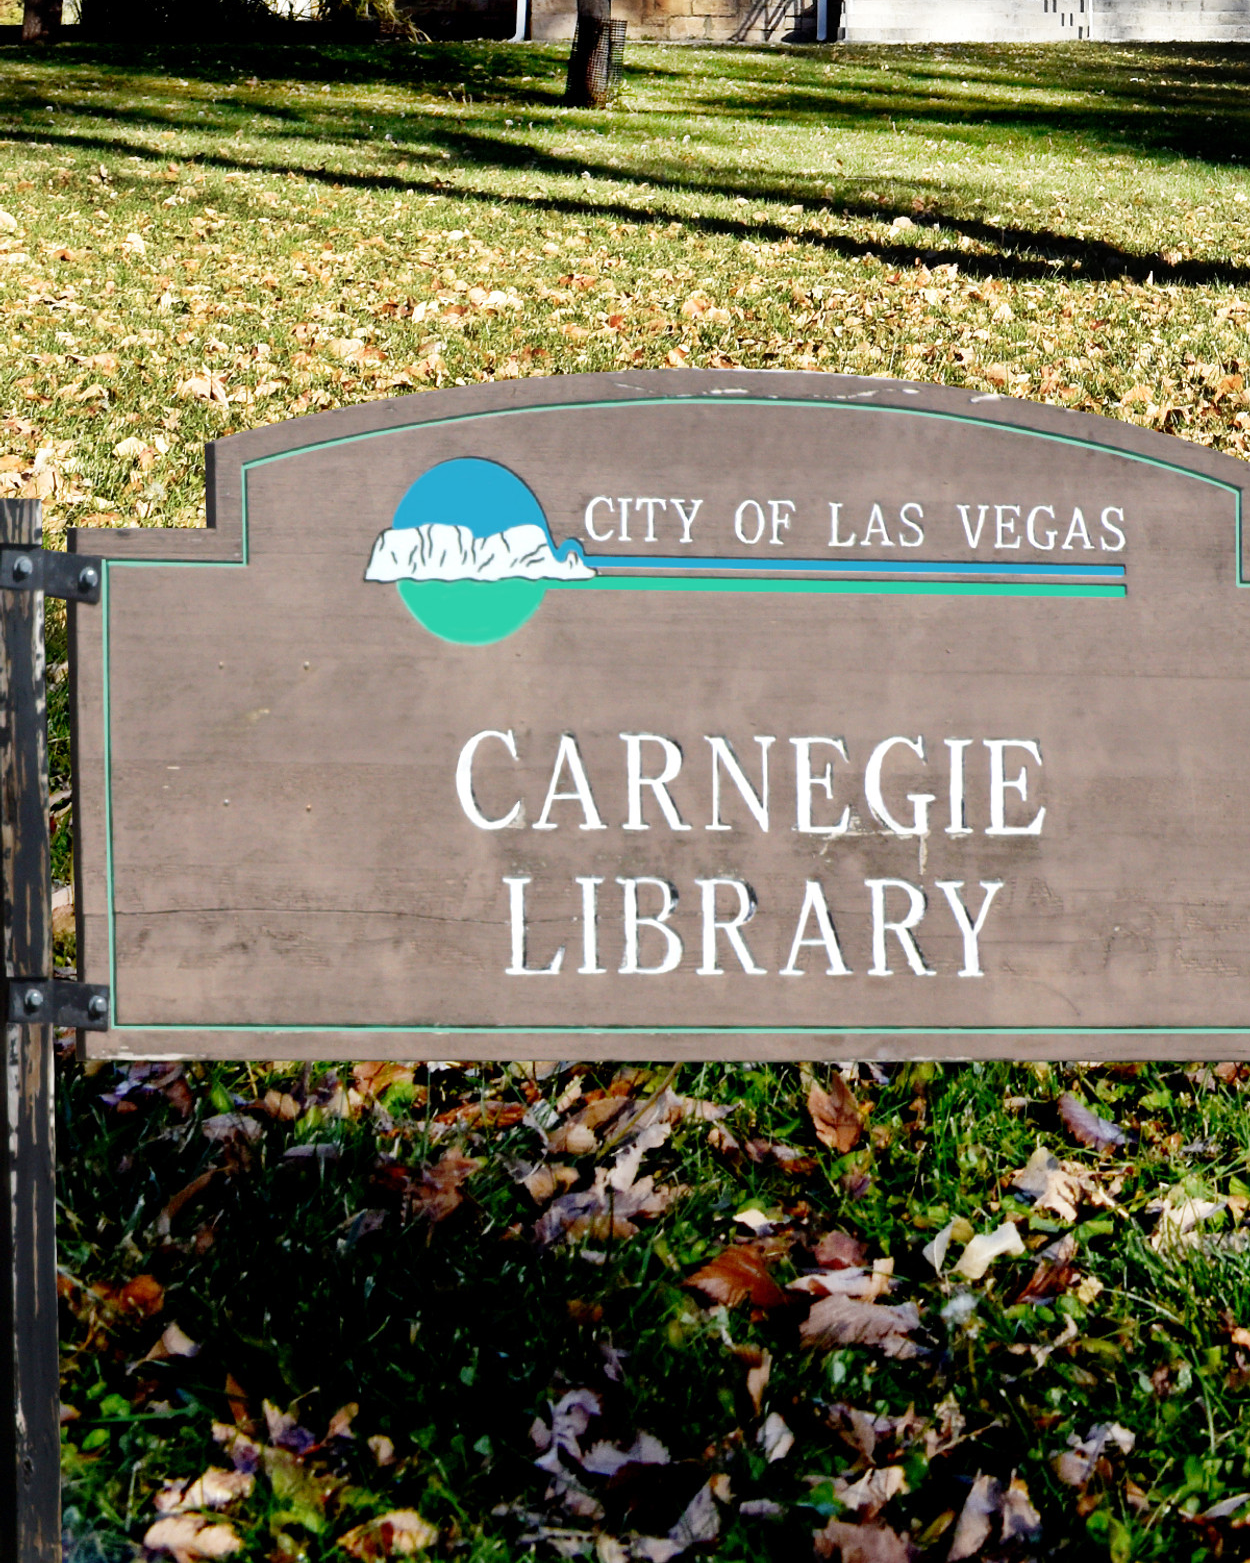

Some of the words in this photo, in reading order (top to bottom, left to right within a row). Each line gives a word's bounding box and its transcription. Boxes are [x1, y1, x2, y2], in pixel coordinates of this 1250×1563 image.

[585, 496, 703, 543] CITY
[734, 499, 796, 545] OF
[828, 502, 926, 547] LAS
[956, 504, 1127, 552] VEGAS
[455, 729, 1047, 835] CARNEGIE
[503, 876, 1003, 977] LIBRARY
